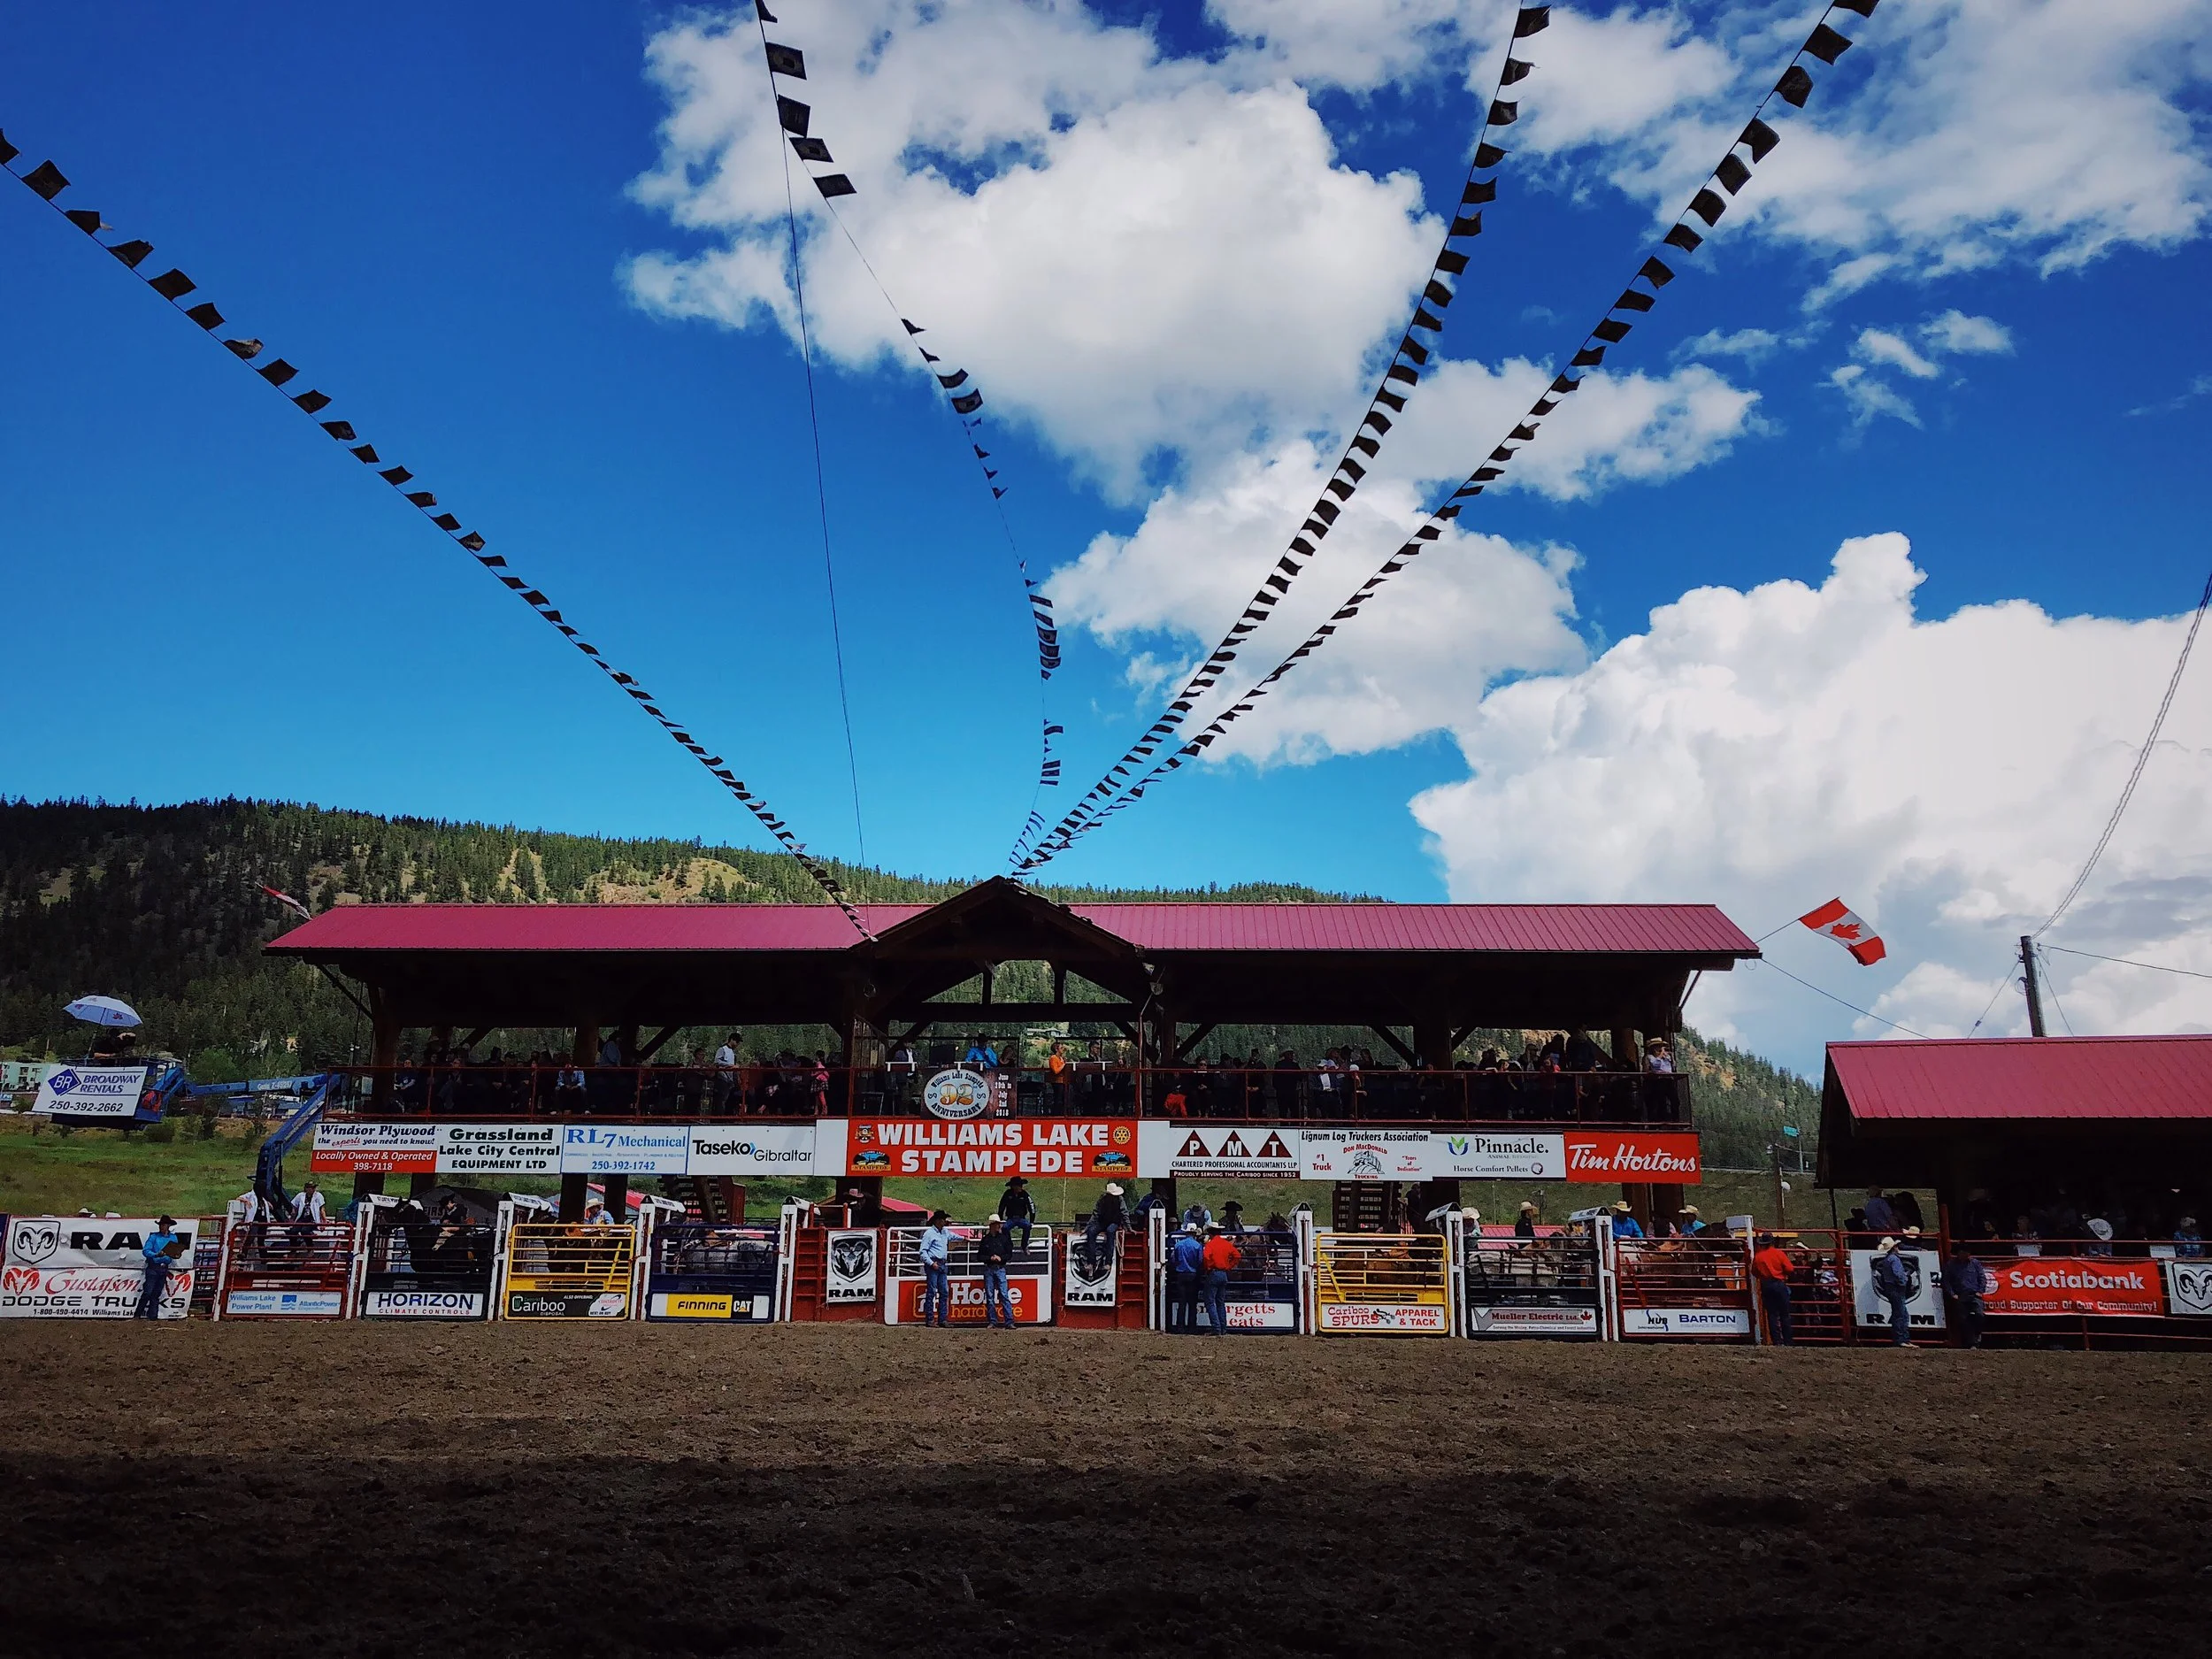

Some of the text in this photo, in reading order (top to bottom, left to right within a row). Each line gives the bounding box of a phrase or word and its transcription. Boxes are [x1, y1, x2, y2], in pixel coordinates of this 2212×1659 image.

[54, 1075, 73, 1089] BR
[83, 1075, 141, 1085] BROADWAY
[80, 1084, 124, 1094] RENTALS
[49, 1100, 124, 1112] 250-392-2662
[931, 1102, 981, 1118] ANNIVERSARY
[320, 1125, 435, 1137] Windsor Plywood
[449, 1128, 553, 1141] Grassland
[877, 1124, 1109, 1147] WILLIAMS LAKE
[1301, 1131, 1429, 1142] Lignum Log Truckers Association
[618, 1135, 686, 1148] Mechanical
[439, 1145, 560, 1157] Lake City Central
[692, 1140, 812, 1162] Taseko Gibraltar
[1189, 1141, 1279, 1156] P M T
[316, 1151, 346, 1161] Locally
[391, 1152, 433, 1161] Operated
[901, 1150, 1083, 1173] STAMPEDE
[1569, 1143, 1696, 1171] Tim Hortons
[353, 1162, 393, 1171] 398-7118
[451, 1160, 547, 1169] EQUIPMENT LTD
[592, 1161, 656, 1171] 250-392-1742
[2009, 1270, 2145, 1290] Scotiabank
[828, 1287, 874, 1298] RAM
[1068, 1293, 1113, 1302] RAM
[2, 1296, 186, 1308] DODGE TRUKS
[378, 1293, 474, 1310] HORIZON
[511, 1295, 566, 1311] Cariboo
[678, 1301, 726, 1310] FINNING
[733, 1301, 752, 1312] CAT
[1984, 1300, 2158, 1312] roud Supporter Of Our Community!
[1328, 1306, 1370, 1316] Cariboo
[1228, 1317, 1263, 1327] eats
[1332, 1314, 1379, 1326] SPURS
[1679, 1315, 1736, 1324] BARTON
[1866, 1314, 1935, 1325] RM
